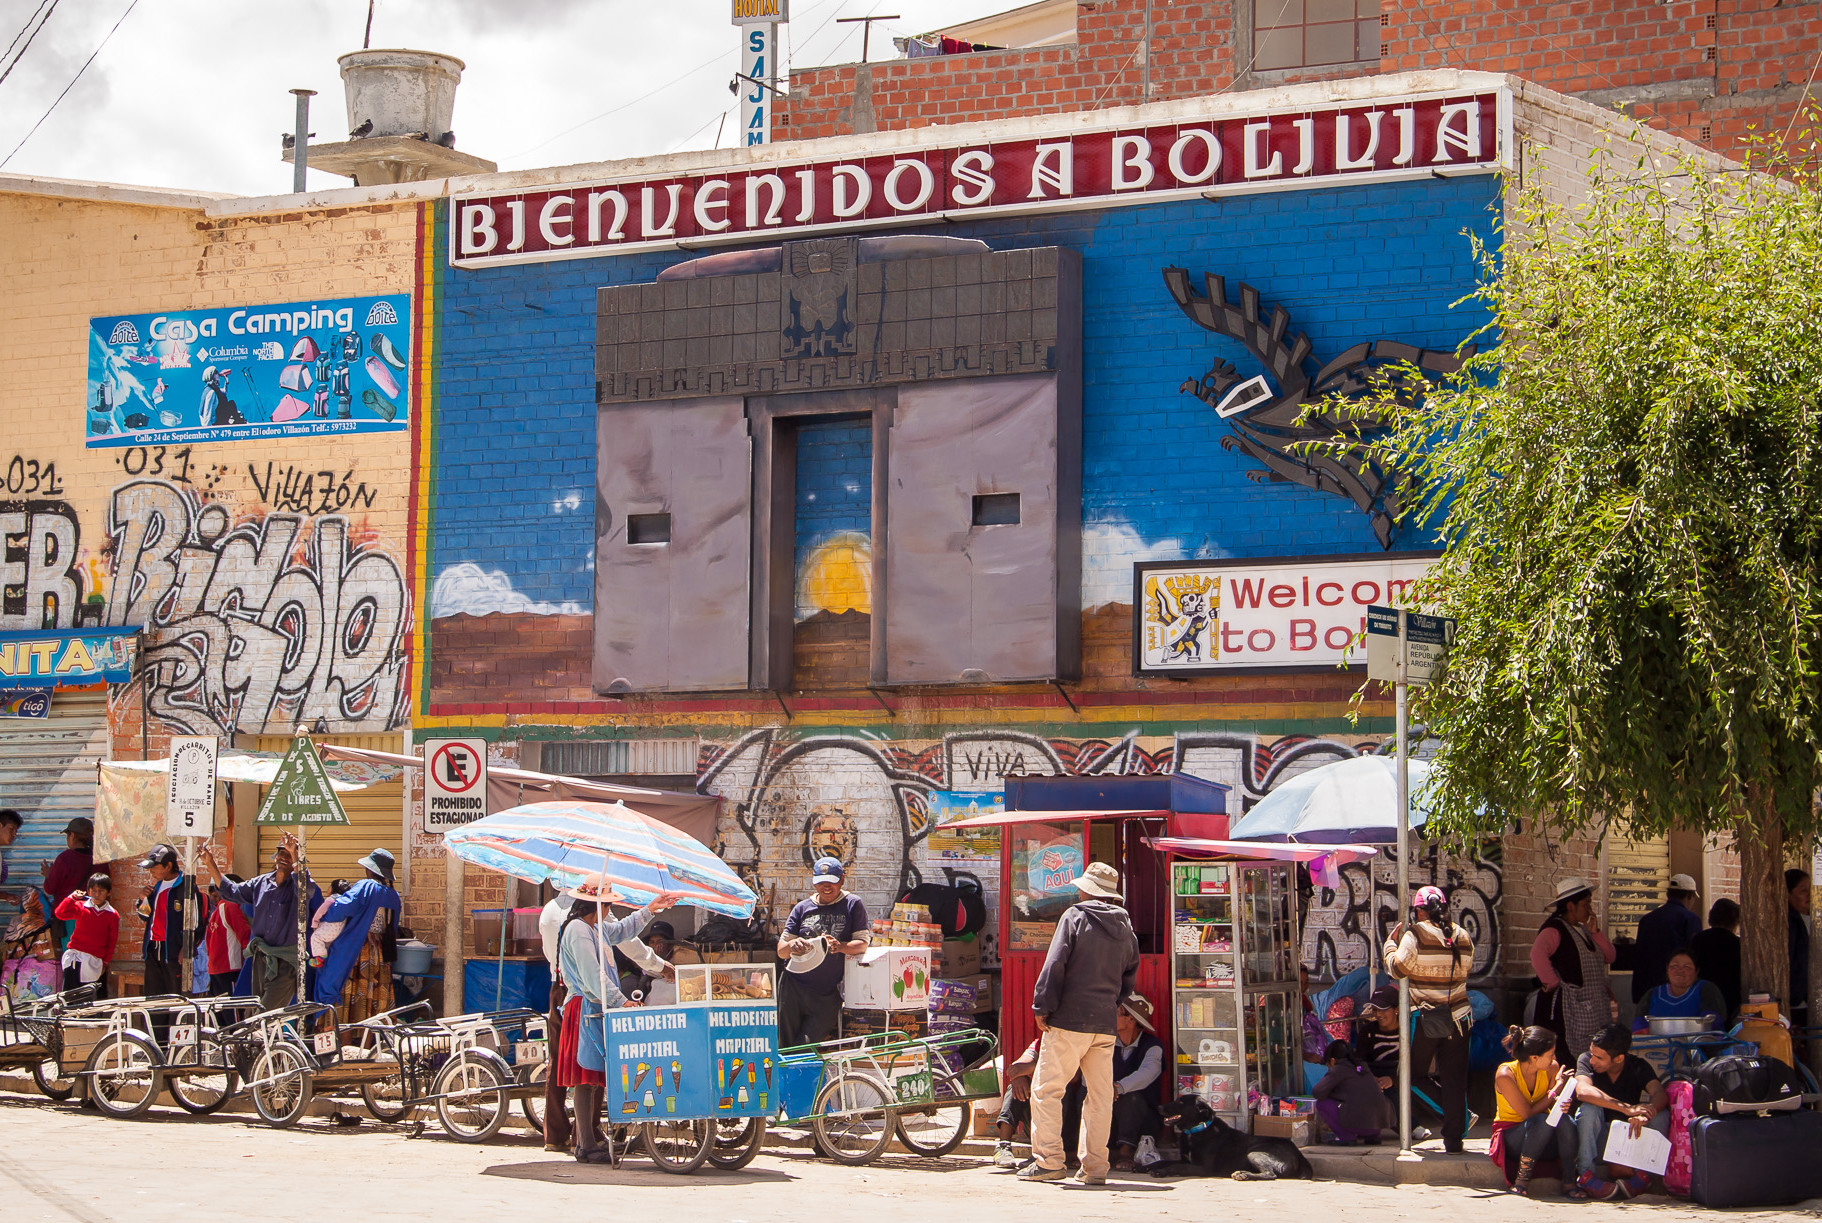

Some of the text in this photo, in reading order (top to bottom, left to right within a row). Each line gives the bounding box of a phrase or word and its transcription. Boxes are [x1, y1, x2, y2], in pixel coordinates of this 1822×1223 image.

[1026, 142, 1074, 199] A
[1111, 101, 1482, 191] BOLIVIA
[149, 304, 354, 344] Casa Camping
[208, 345, 249, 358] Columbia
[135, 434, 152, 443] Calle
[153, 433, 162, 442] 24
[162, 433, 170, 442] de
[171, 430, 210, 442] Septiembre
[220, 429, 232, 438] 479
[232, 429, 250, 438] entre
[282, 424, 310, 435] Villazón
[331, 422, 358, 432] 5973232
[1229, 575, 1447, 610] Welcom
[1220, 621, 1276, 654] to
[1410, 643, 1430, 651] AVENIDA
[298, 737, 307, 750] P
[287, 794, 322, 805] LIBRES
[431, 796, 483, 810] PROHIBIDO
[184, 811, 195, 828] 5
[269, 812, 332, 822] 2 DE AGOSTO
[1044, 864, 1075, 891] AQUÍ
[174, 1029, 190, 1041] 47
[318, 1035, 332, 1049] 75
[901, 1079, 926, 1098] 240
